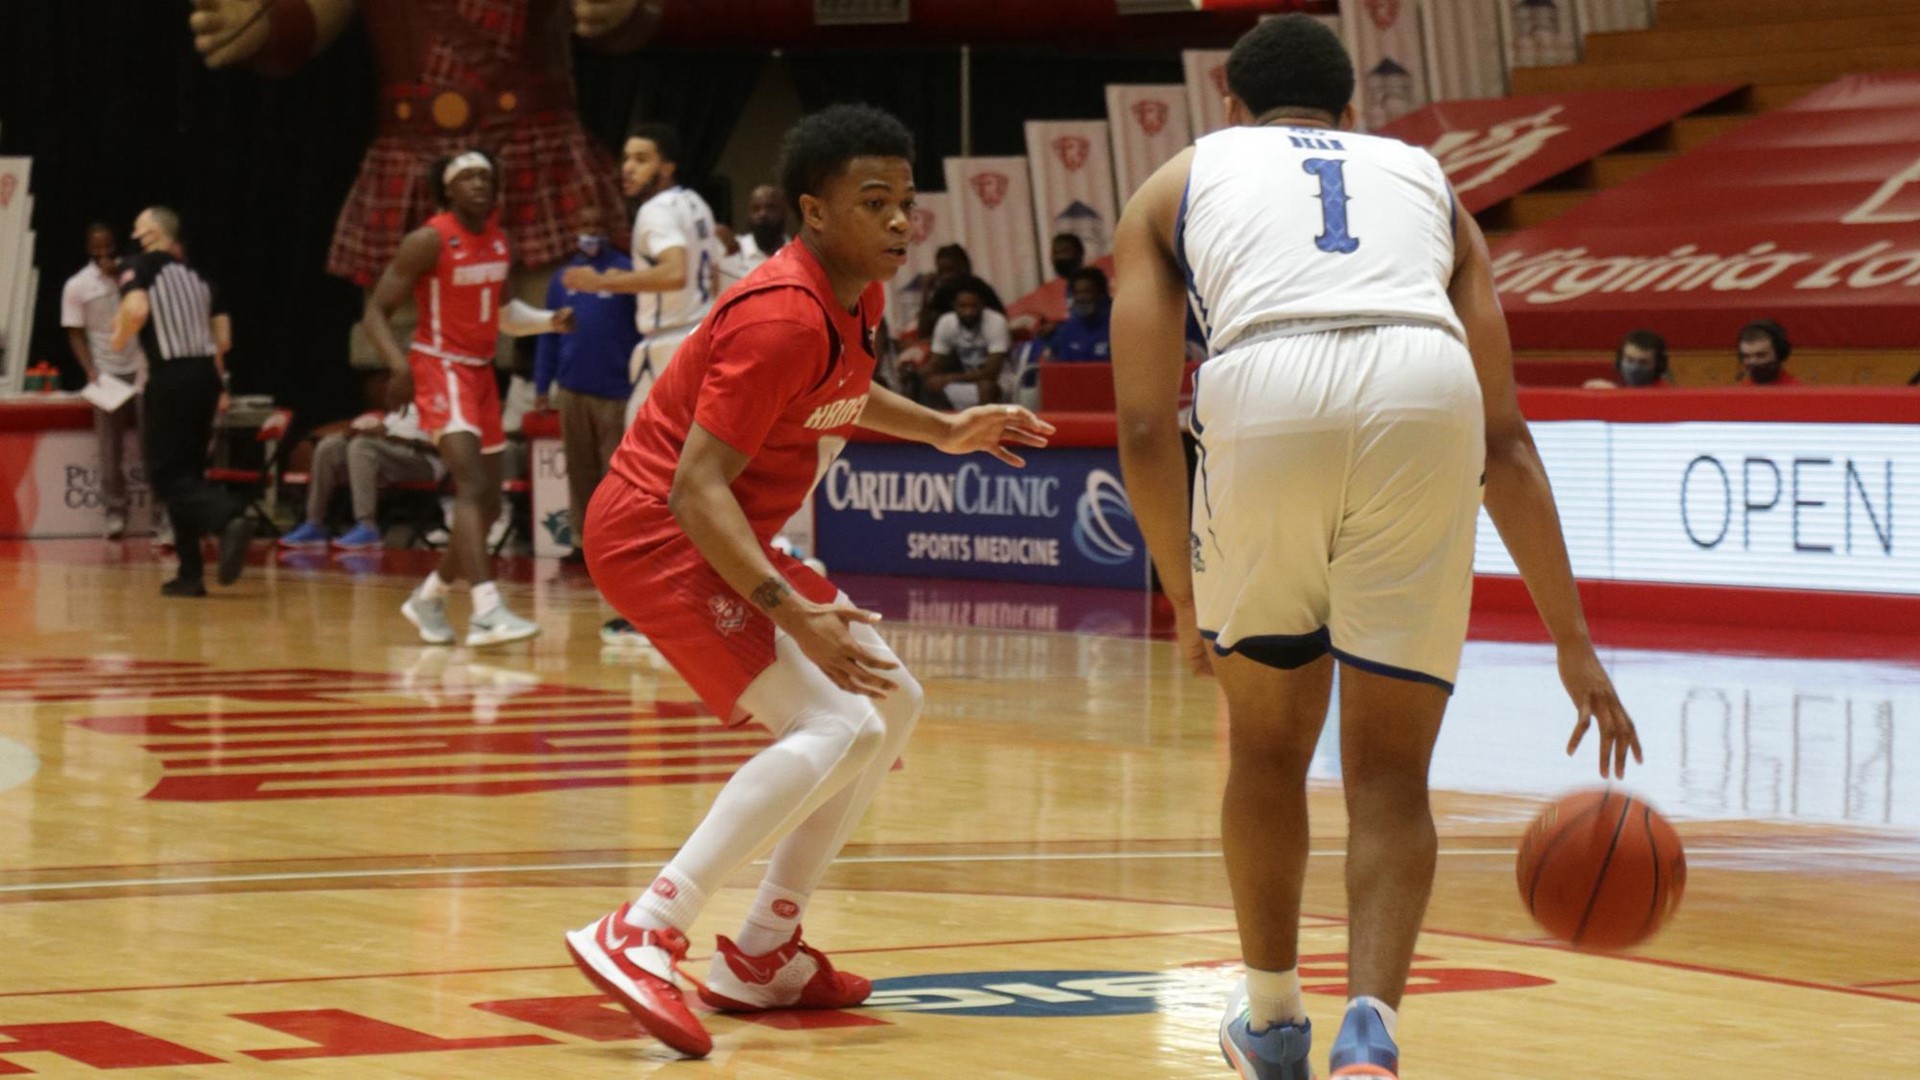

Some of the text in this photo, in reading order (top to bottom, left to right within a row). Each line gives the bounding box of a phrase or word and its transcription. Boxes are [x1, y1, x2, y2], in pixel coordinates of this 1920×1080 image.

[1301, 158, 1360, 254] 1
[907, 531, 1060, 567] SPORTS MEDICINE
[1680, 454, 1893, 556] OPEN
